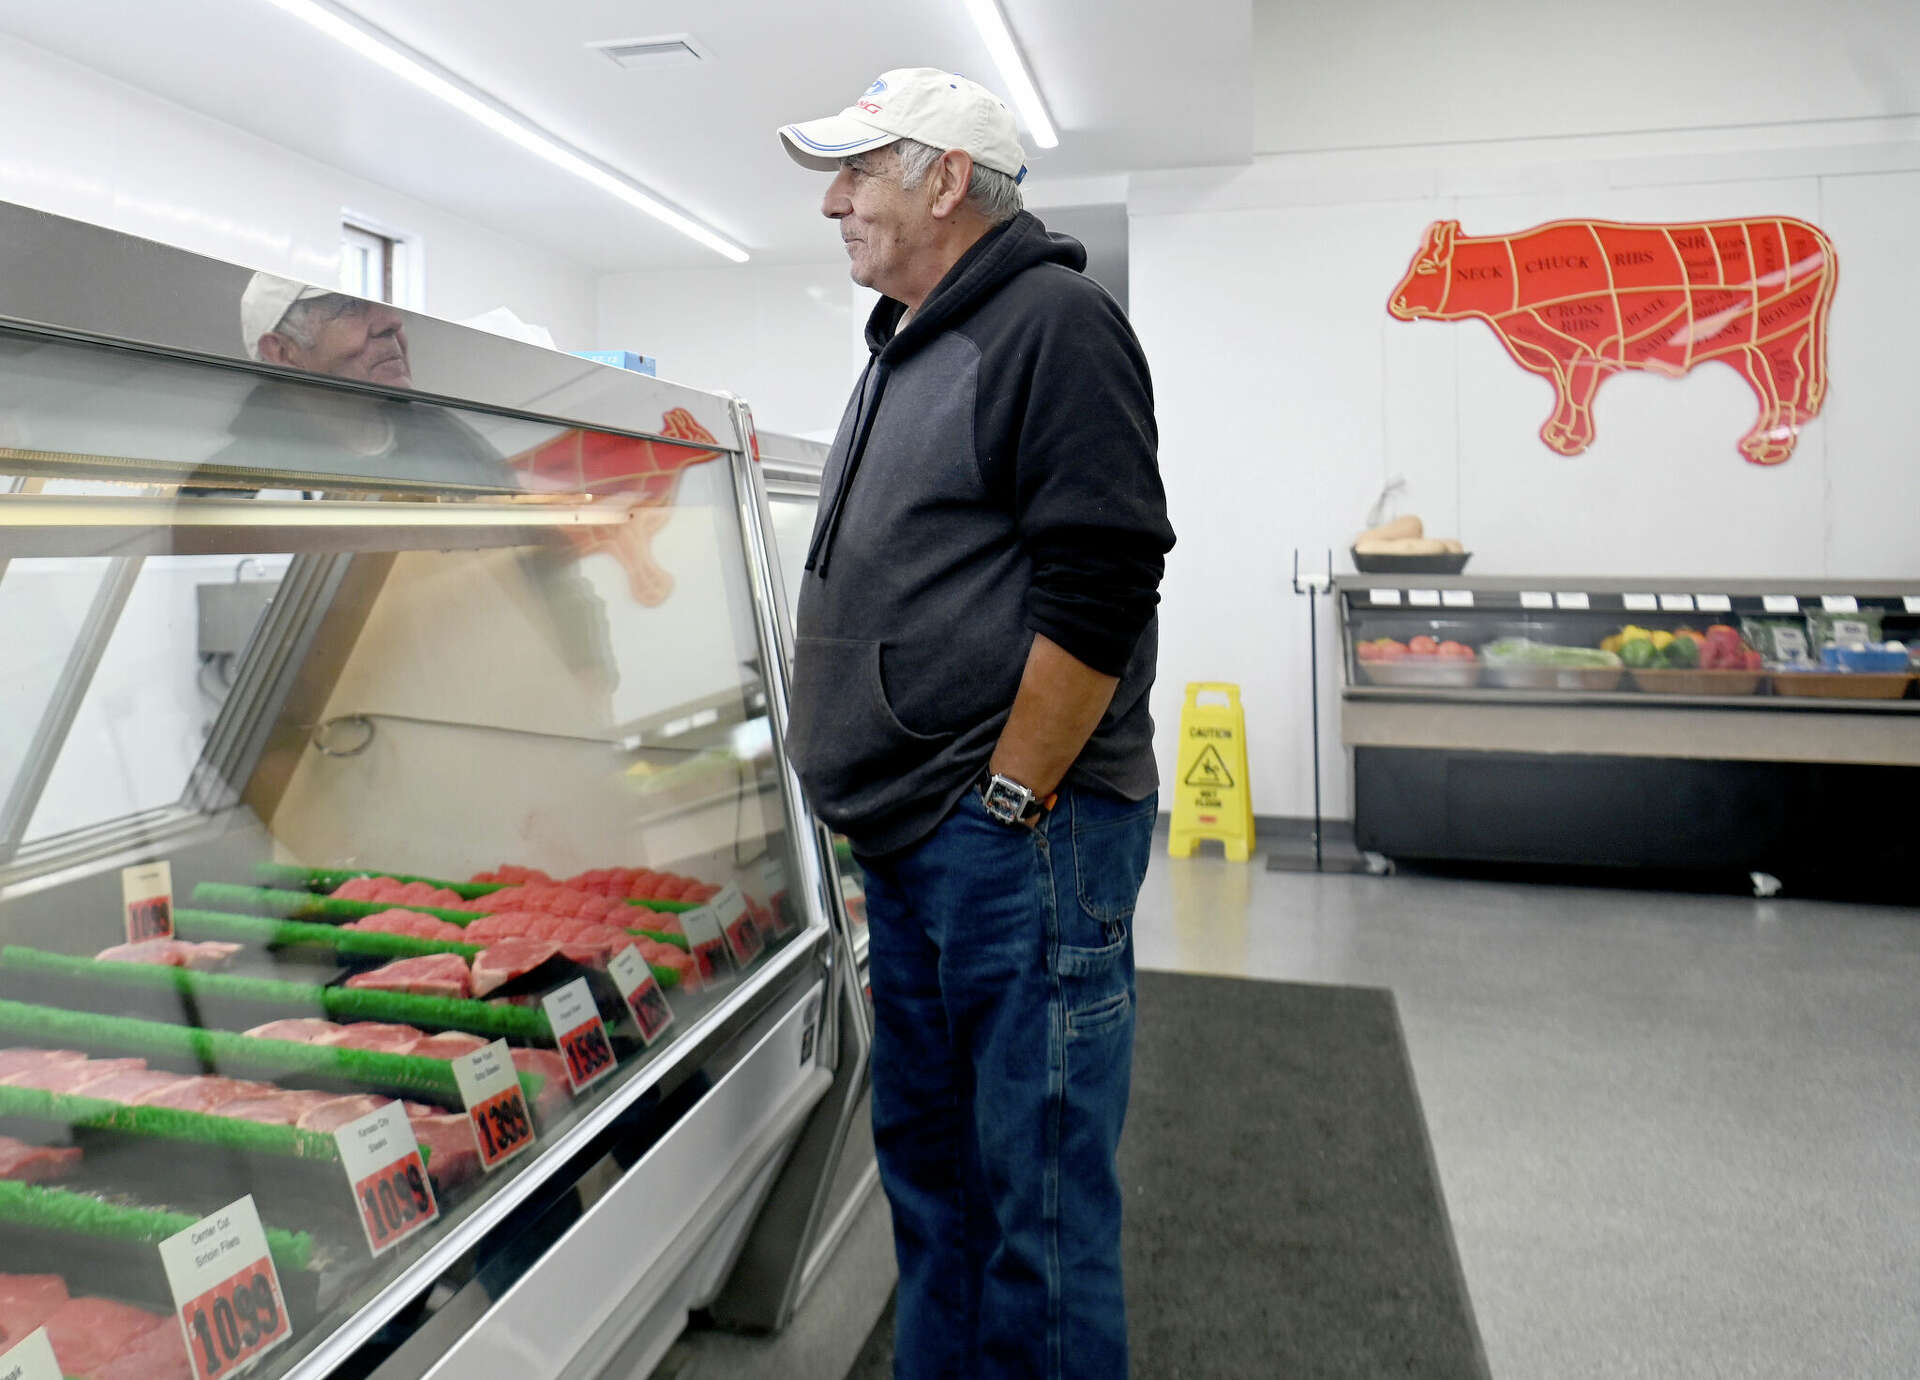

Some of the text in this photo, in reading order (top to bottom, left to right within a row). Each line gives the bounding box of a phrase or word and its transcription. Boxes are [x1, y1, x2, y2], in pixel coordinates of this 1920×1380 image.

[1524, 255, 1590, 274] CHUCK
[1614, 250, 1655, 266] RIBS
[1457, 264, 1503, 281] NECK
[1546, 302, 1604, 319] CROSS
[1626, 298, 1666, 326] PLATE
[1560, 318, 1601, 333] RIBS
[1189, 726, 1233, 739] CAUTION
[216, 1217, 231, 1231] Cut
